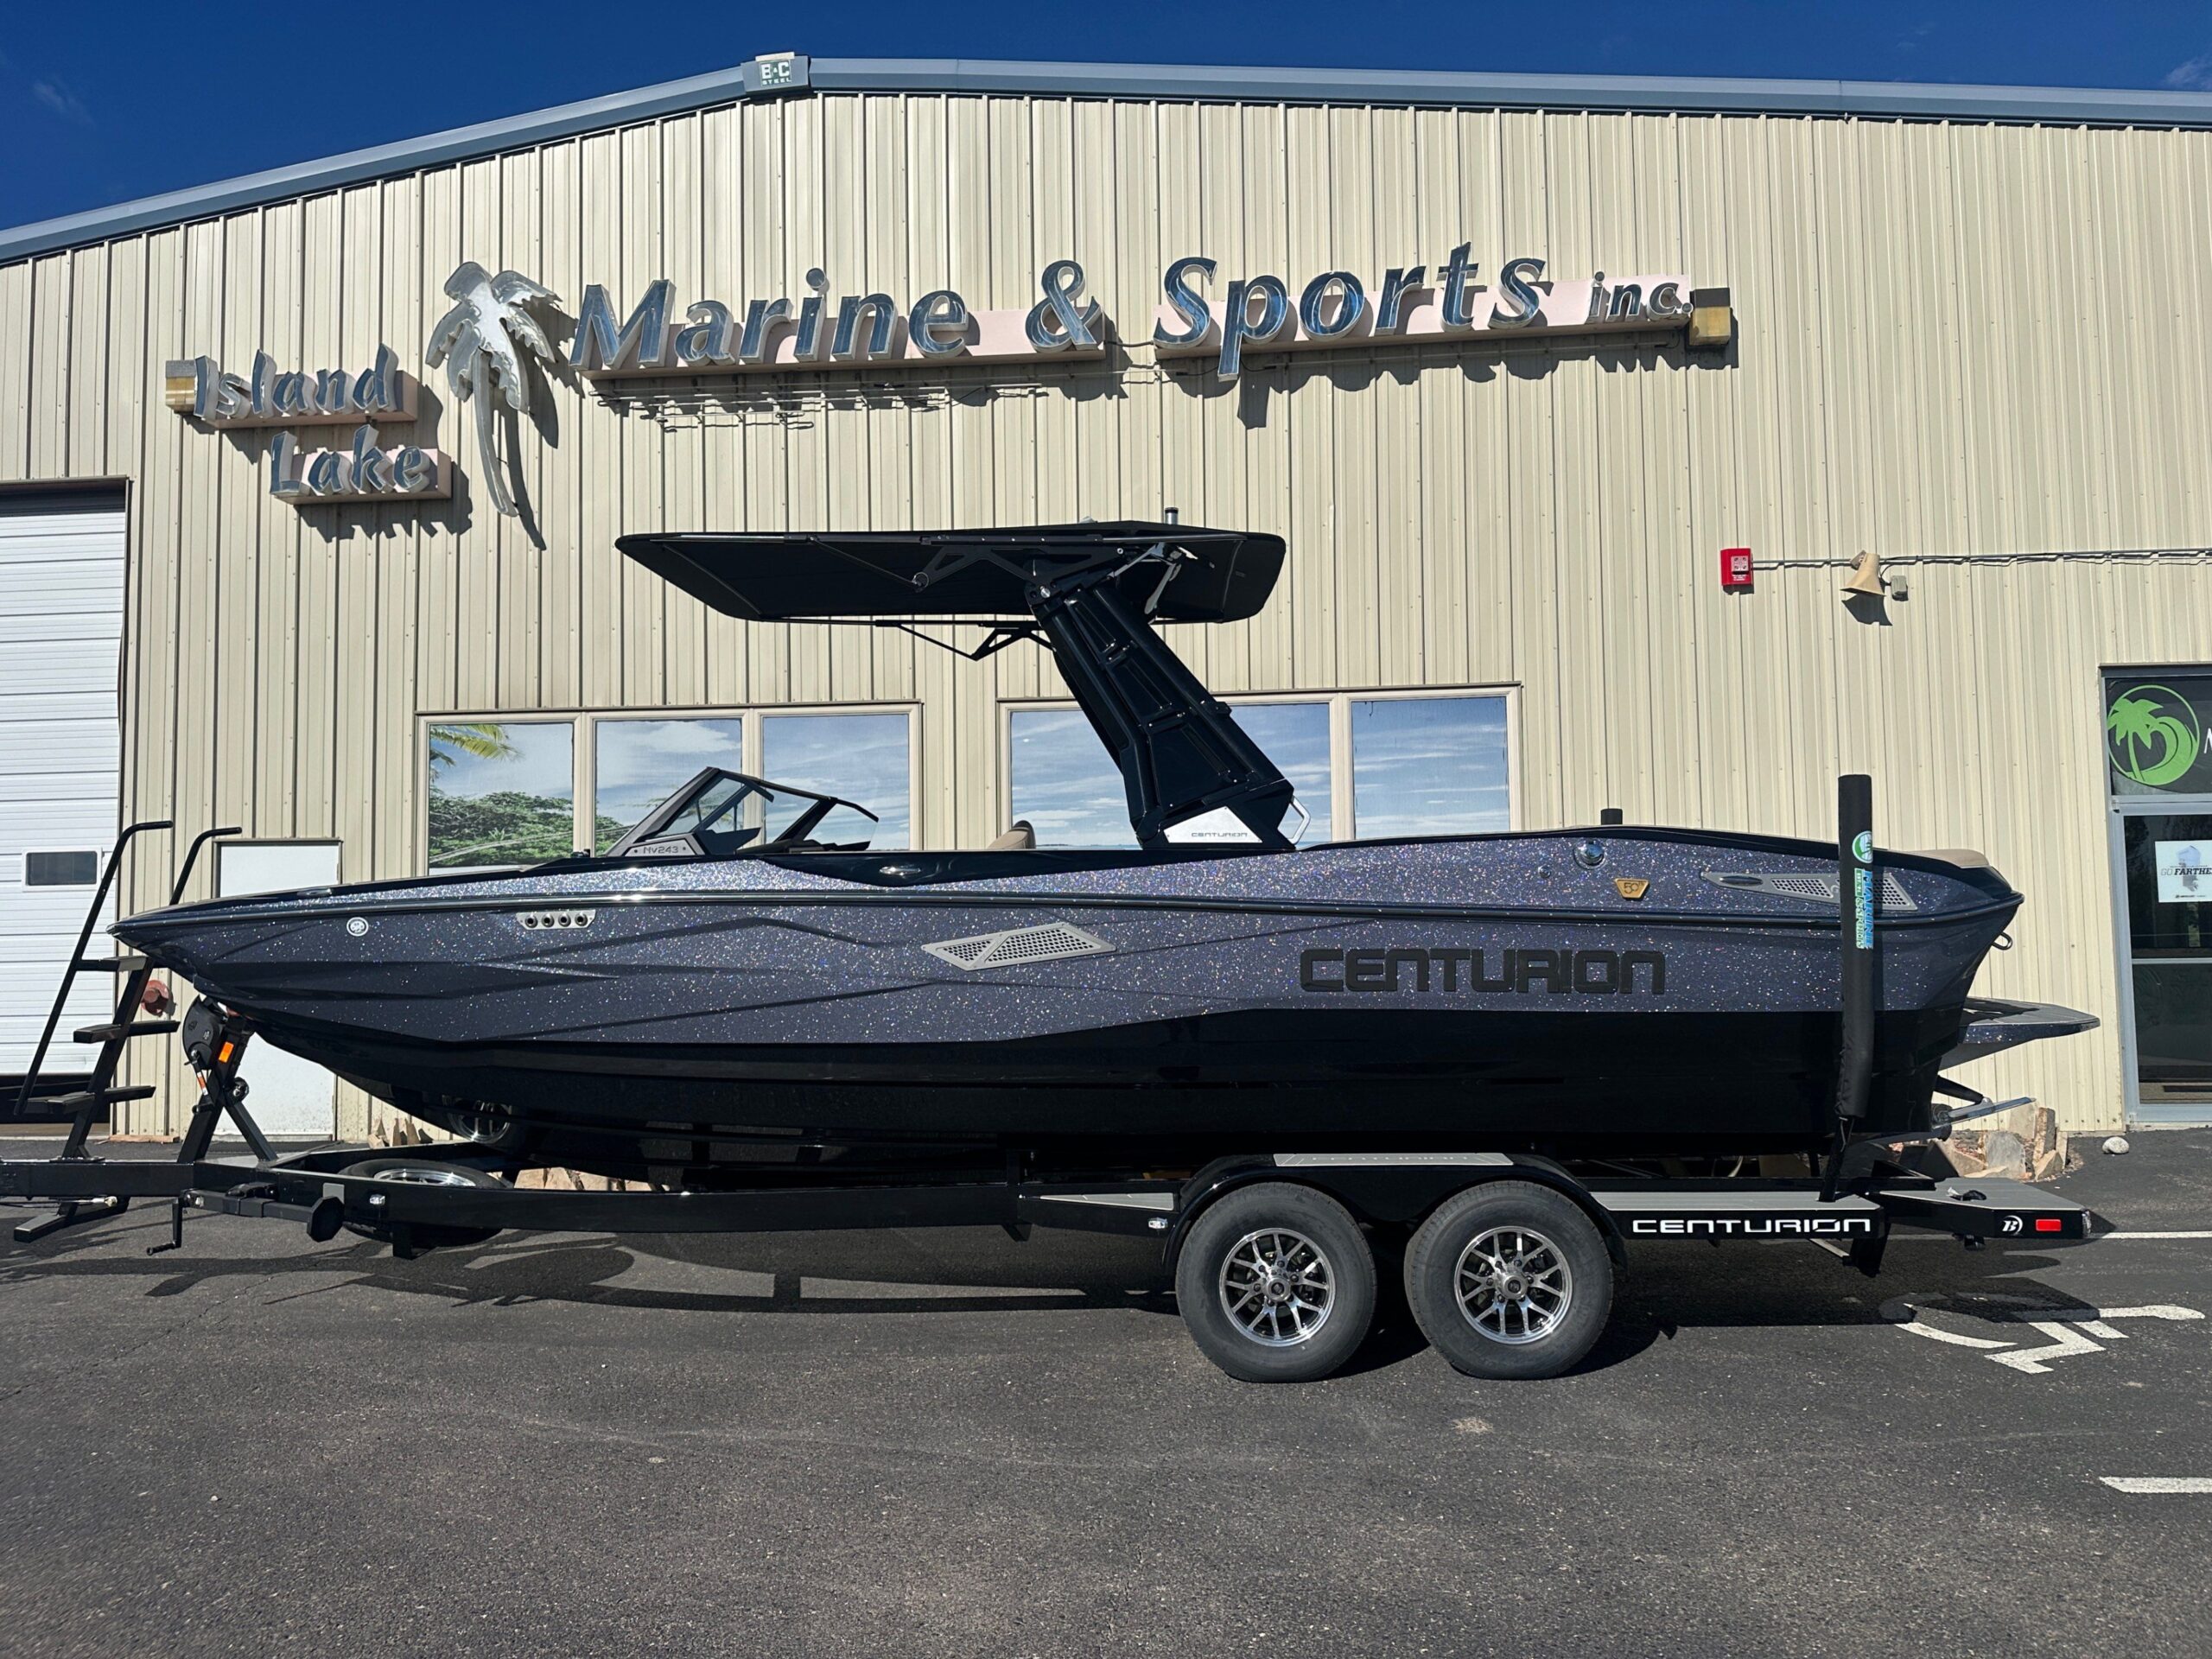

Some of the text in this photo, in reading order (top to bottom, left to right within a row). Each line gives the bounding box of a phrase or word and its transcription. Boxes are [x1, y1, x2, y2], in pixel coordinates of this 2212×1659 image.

[762, 77, 792, 86] STEEL
[569, 242, 1693, 381] Marine & Sports inc.
[194, 343, 399, 420] Island
[270, 423, 430, 495] Lake
[2160, 868, 2173, 876] GO
[1864, 870, 1873, 950] MARINE
[1300, 950, 1666, 994] CENTURION
[1632, 1218, 1871, 1233] CENTURION
